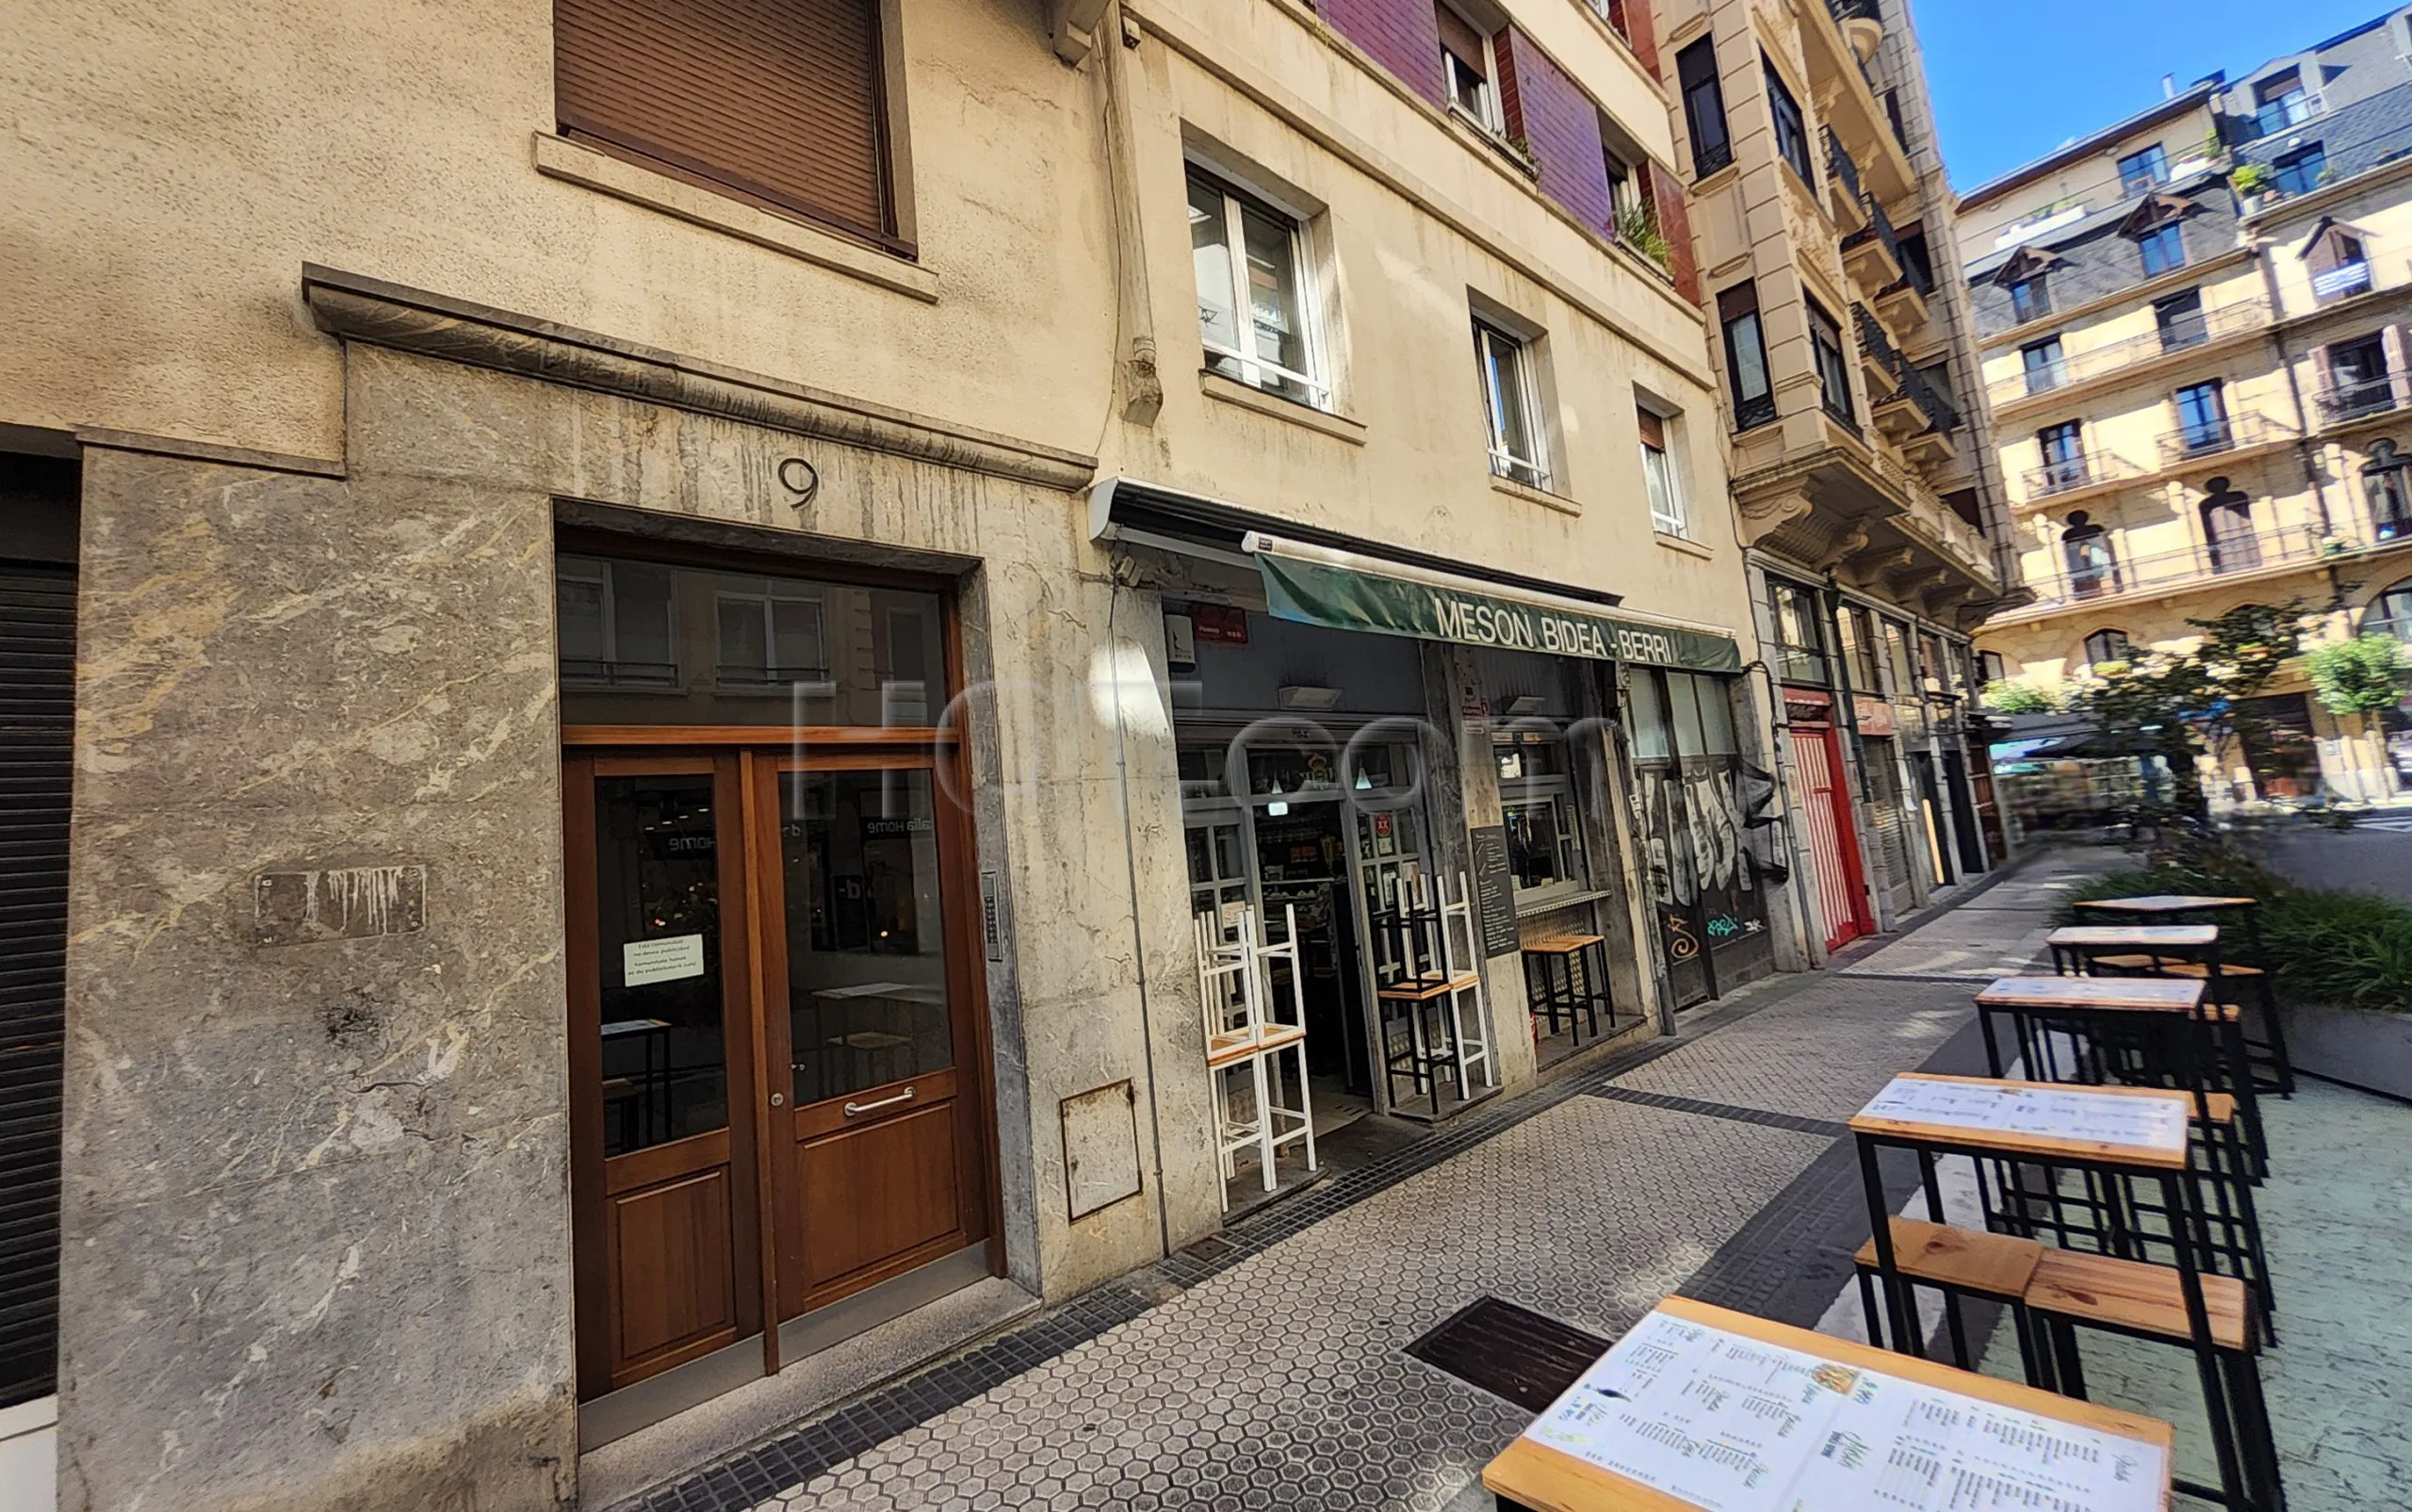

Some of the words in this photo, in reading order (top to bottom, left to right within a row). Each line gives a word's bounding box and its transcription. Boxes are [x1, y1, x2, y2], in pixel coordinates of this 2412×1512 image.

[777, 458, 817, 510] 9
[1434, 597, 1534, 647] MESON
[1540, 617, 1606, 657] BIDEA
